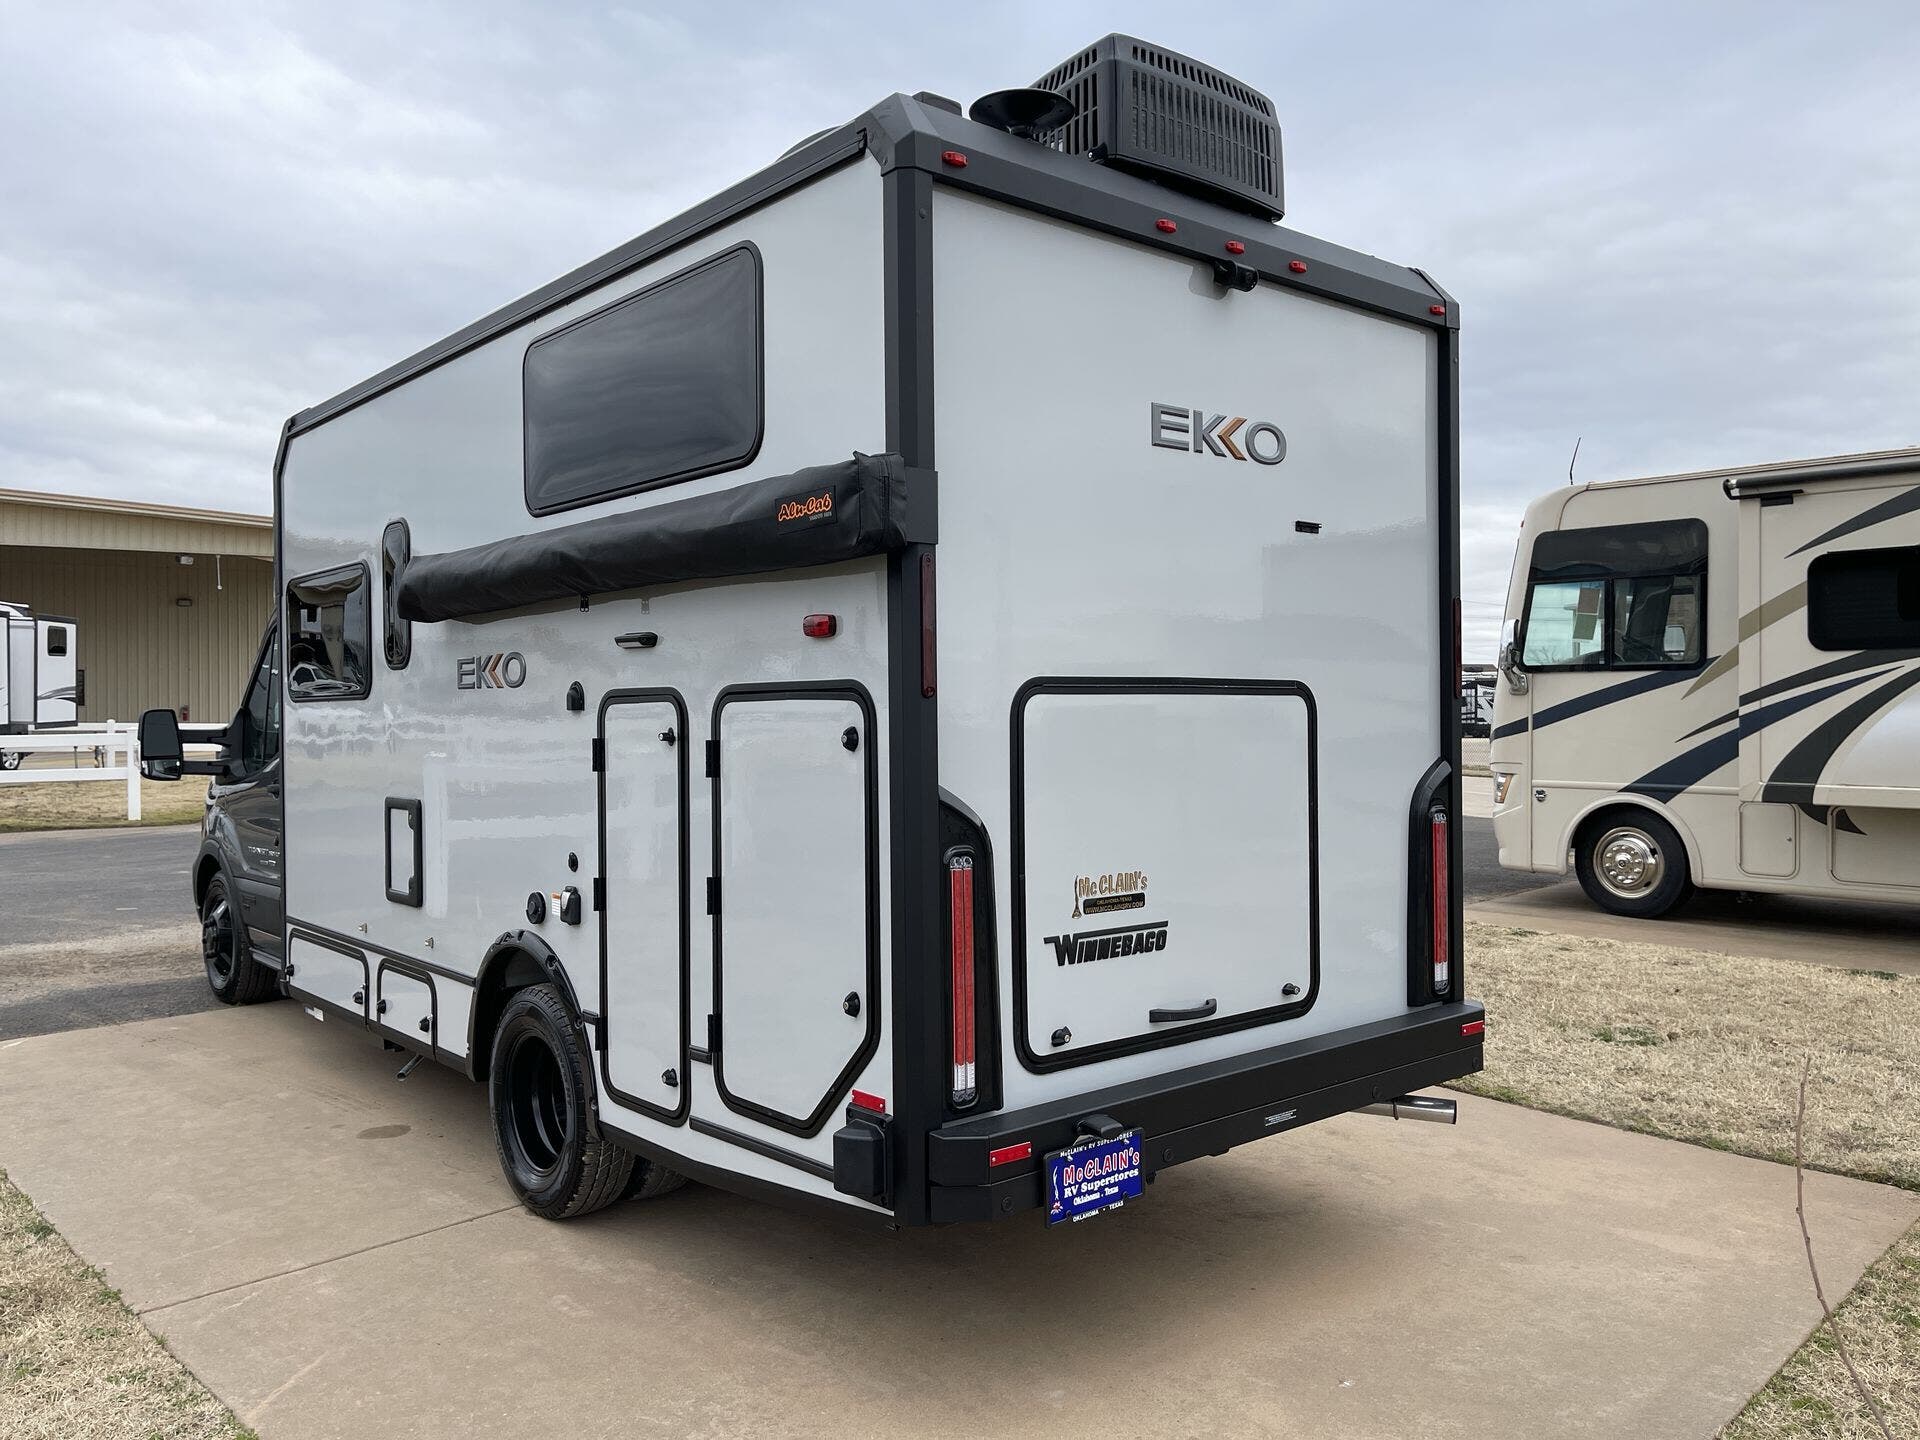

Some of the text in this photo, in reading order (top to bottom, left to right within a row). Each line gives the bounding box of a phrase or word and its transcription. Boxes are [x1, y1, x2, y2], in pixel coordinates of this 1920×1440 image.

[1151, 402, 1287, 466] EKKO
[778, 493, 832, 521] Alu-Cab
[457, 652, 527, 690] EKKO
[1044, 923, 1168, 967] WINNEBAGO
[1063, 1147, 1140, 1186] McCLAIN's
[1064, 1168, 1139, 1199] RV Superstores
[1073, 1186, 1119, 1206] Oklahoma Texas
[1073, 1201, 1124, 1223] OKLAHOMA TEXAS
